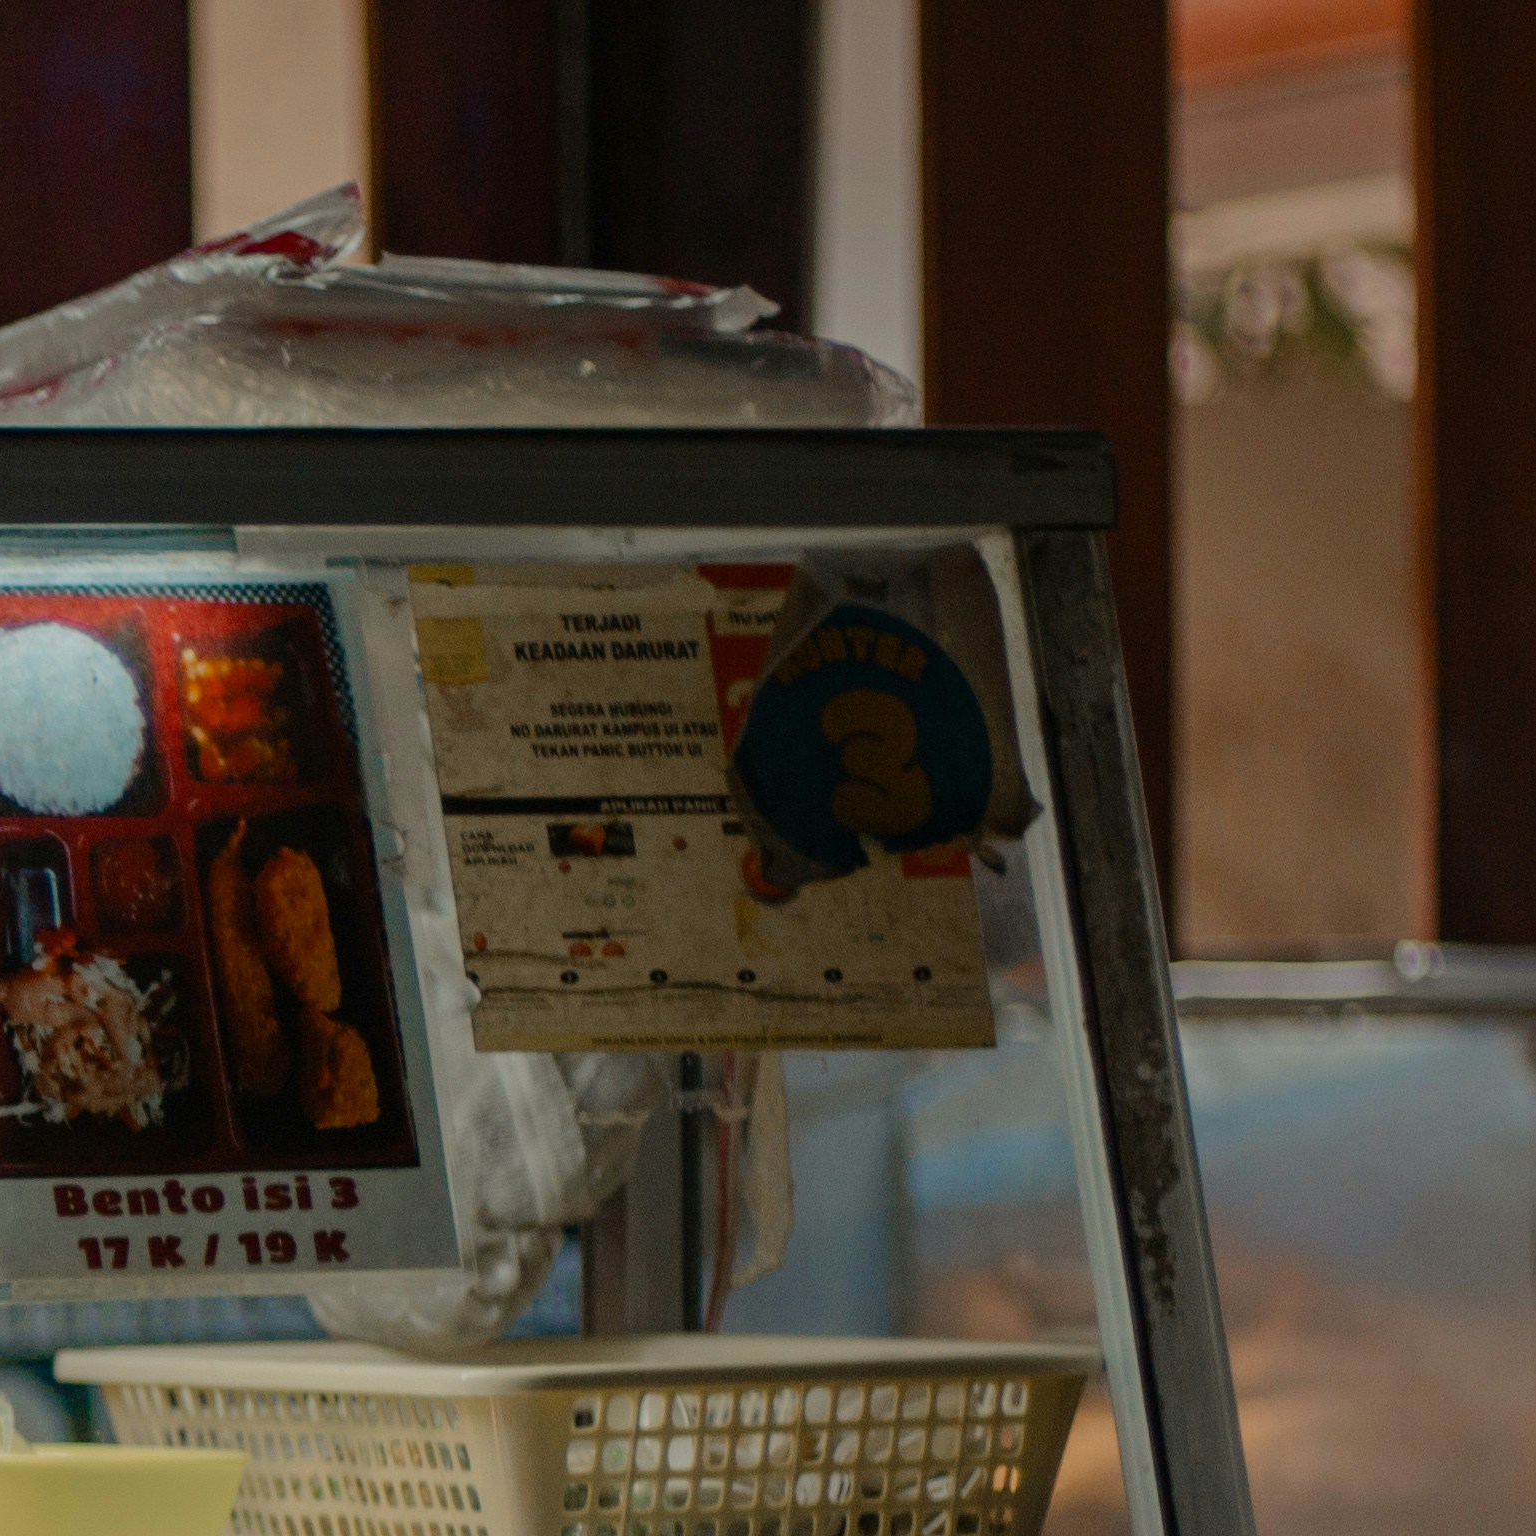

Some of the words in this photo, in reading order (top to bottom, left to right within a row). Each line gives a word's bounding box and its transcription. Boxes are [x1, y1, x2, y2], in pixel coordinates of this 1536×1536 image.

[559, 613, 642, 633] TERJADI
[514, 641, 607, 661] KEADAAN
[611, 640, 700, 660] DARURAT
[549, 702, 605, 717] SEGERA
[608, 702, 672, 717] HUBUNGI
[510, 723, 530, 738] NO
[534, 723, 598, 738] DARURAT
[602, 722, 660, 737] KAMPUS
[683, 722, 718, 736] ATAU
[531, 744, 579, 758] TEKAN
[583, 744, 623, 757] PANIC
[821, 688, 931, 836] 3
[53, 1179, 225, 1218] Bento
[241, 1174, 313, 1212] isi
[328, 1176, 360, 1210] 3
[78, 1236, 130, 1270] 17
[147, 1235, 185, 1268] K
[204, 1233, 220, 1267] /
[238, 1230, 297, 1265] 19
[313, 1230, 350, 1263] K
